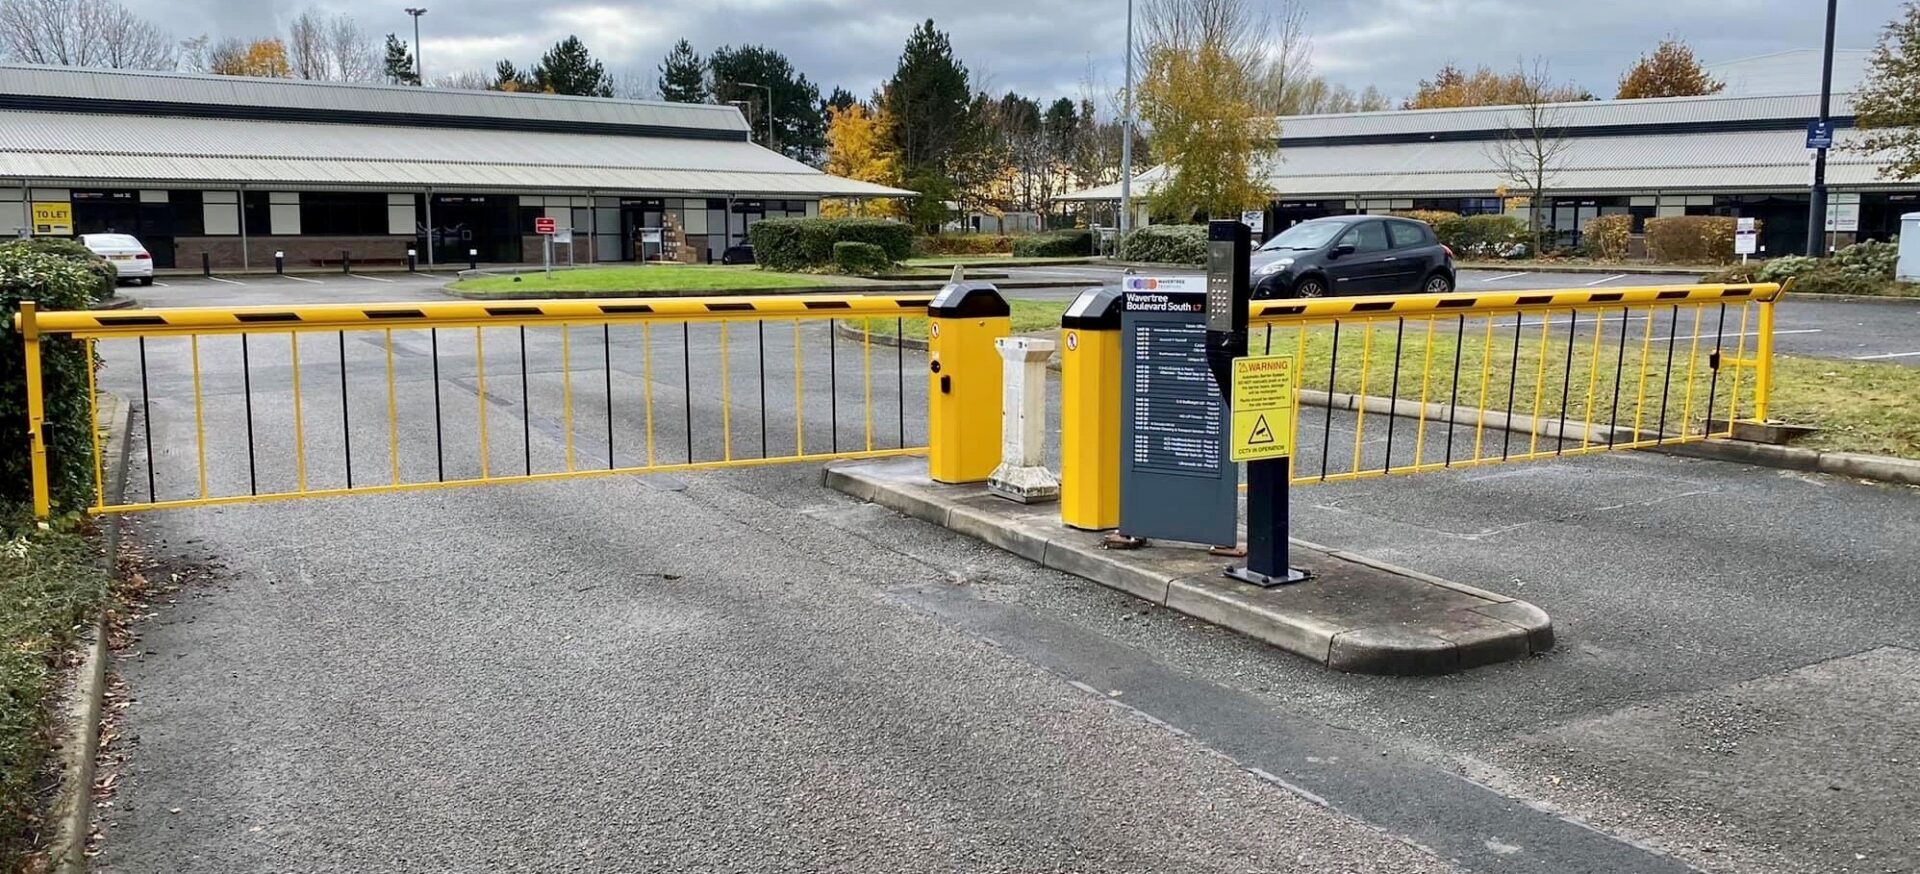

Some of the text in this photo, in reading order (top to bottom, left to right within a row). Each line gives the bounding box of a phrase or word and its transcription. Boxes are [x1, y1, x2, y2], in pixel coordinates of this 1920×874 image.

[36, 210, 68, 218] TO LET
[1126, 292, 1168, 302] Wavertree
[1126, 302, 1167, 310] Boulevard
[1168, 302, 1192, 312] South
[1248, 360, 1288, 372] WARNING
